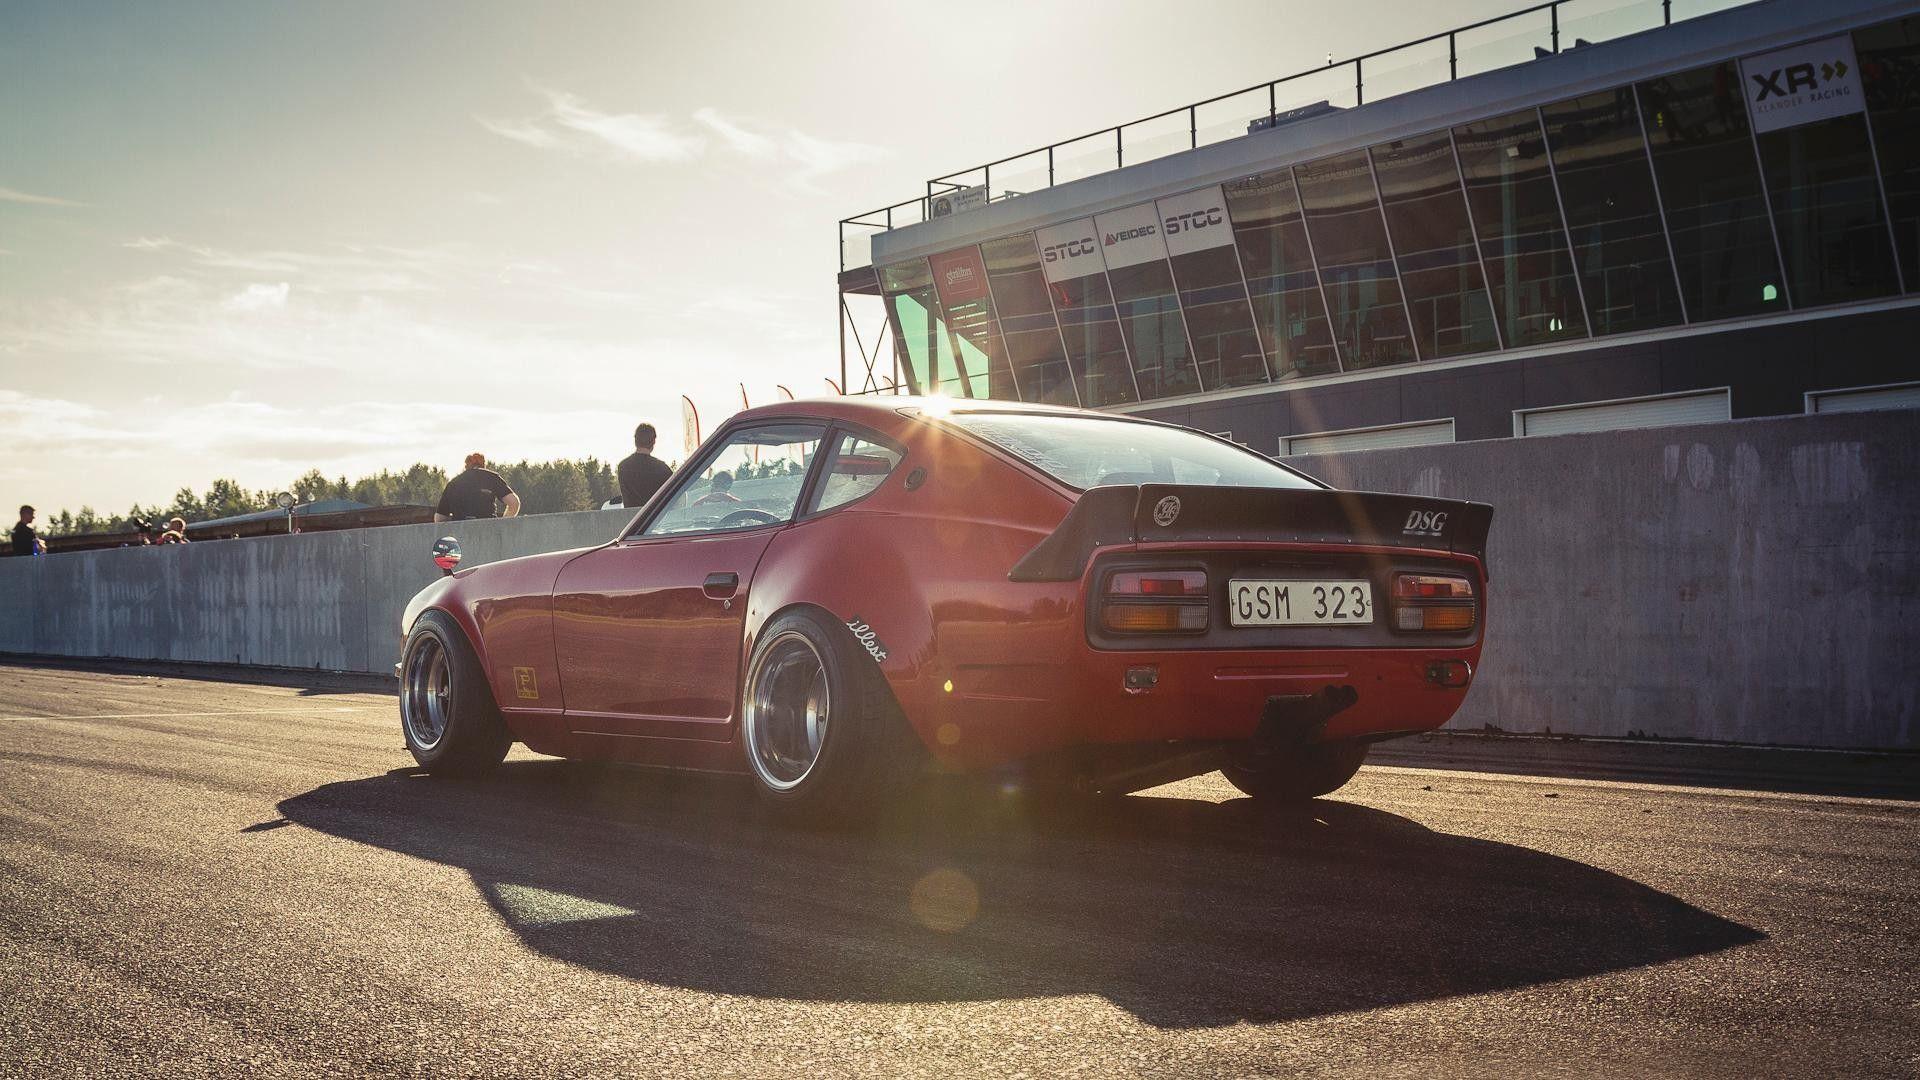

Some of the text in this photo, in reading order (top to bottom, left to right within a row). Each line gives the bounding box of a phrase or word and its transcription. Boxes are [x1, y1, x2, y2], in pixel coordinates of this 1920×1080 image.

[1752, 62, 1818, 102] XR
[1112, 225, 1156, 244] VEIDEC
[1165, 207, 1223, 235] STCC
[1043, 237, 1095, 263] STCC
[1404, 510, 1448, 532] DSG
[1237, 585, 1367, 620] GSM 323
[845, 620, 887, 662] illest
